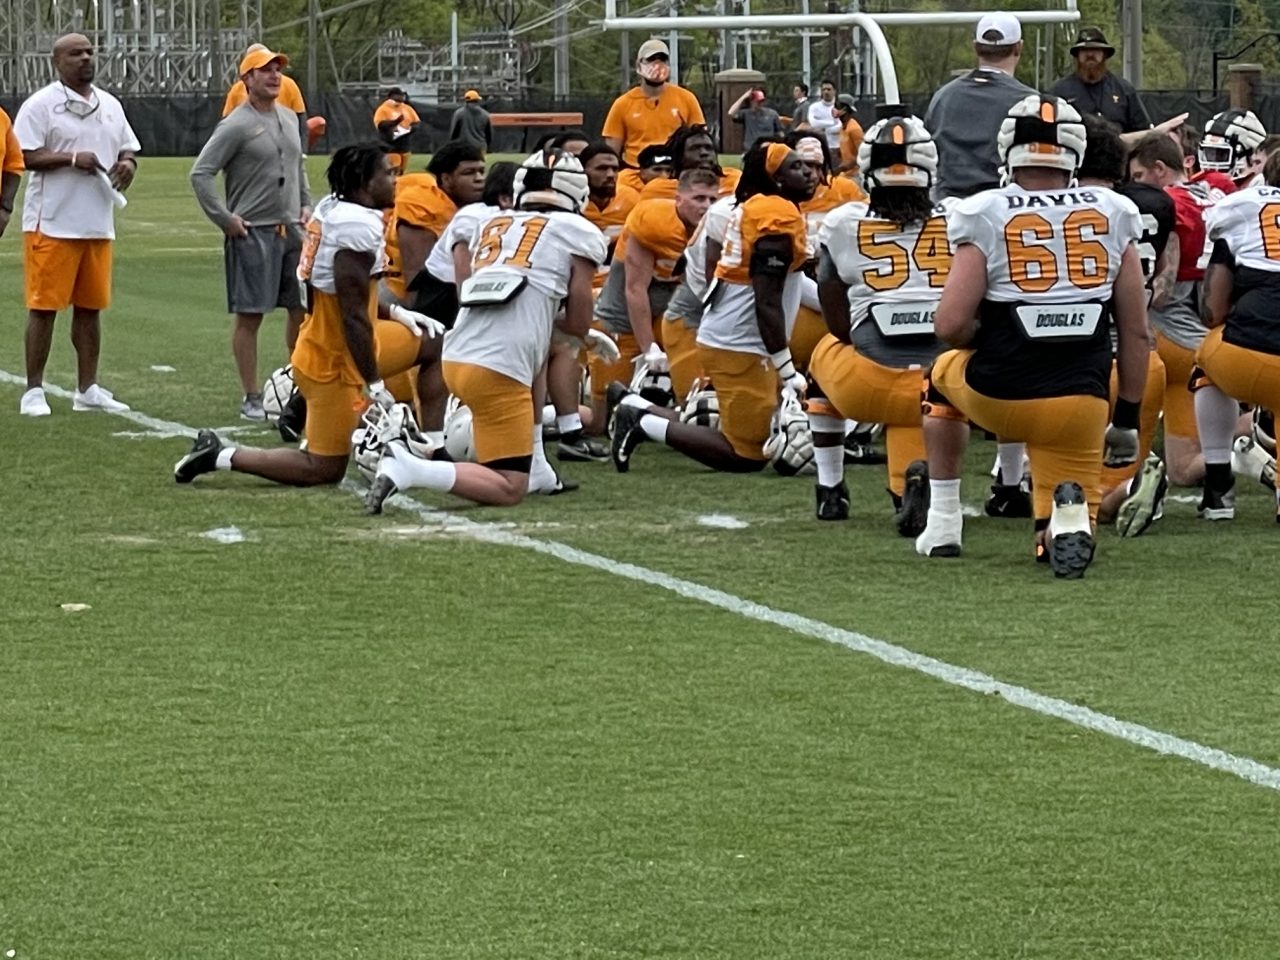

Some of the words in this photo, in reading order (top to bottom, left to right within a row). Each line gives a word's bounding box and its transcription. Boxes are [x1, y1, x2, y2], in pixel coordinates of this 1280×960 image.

[1006, 190, 1098, 209] DAVIS
[472, 215, 549, 270] 81
[858, 215, 953, 291] 54
[1004, 208, 1110, 293] 66
[890, 312, 935, 326] DOUGLAS
[1035, 312, 1086, 328] DOUGLAS
